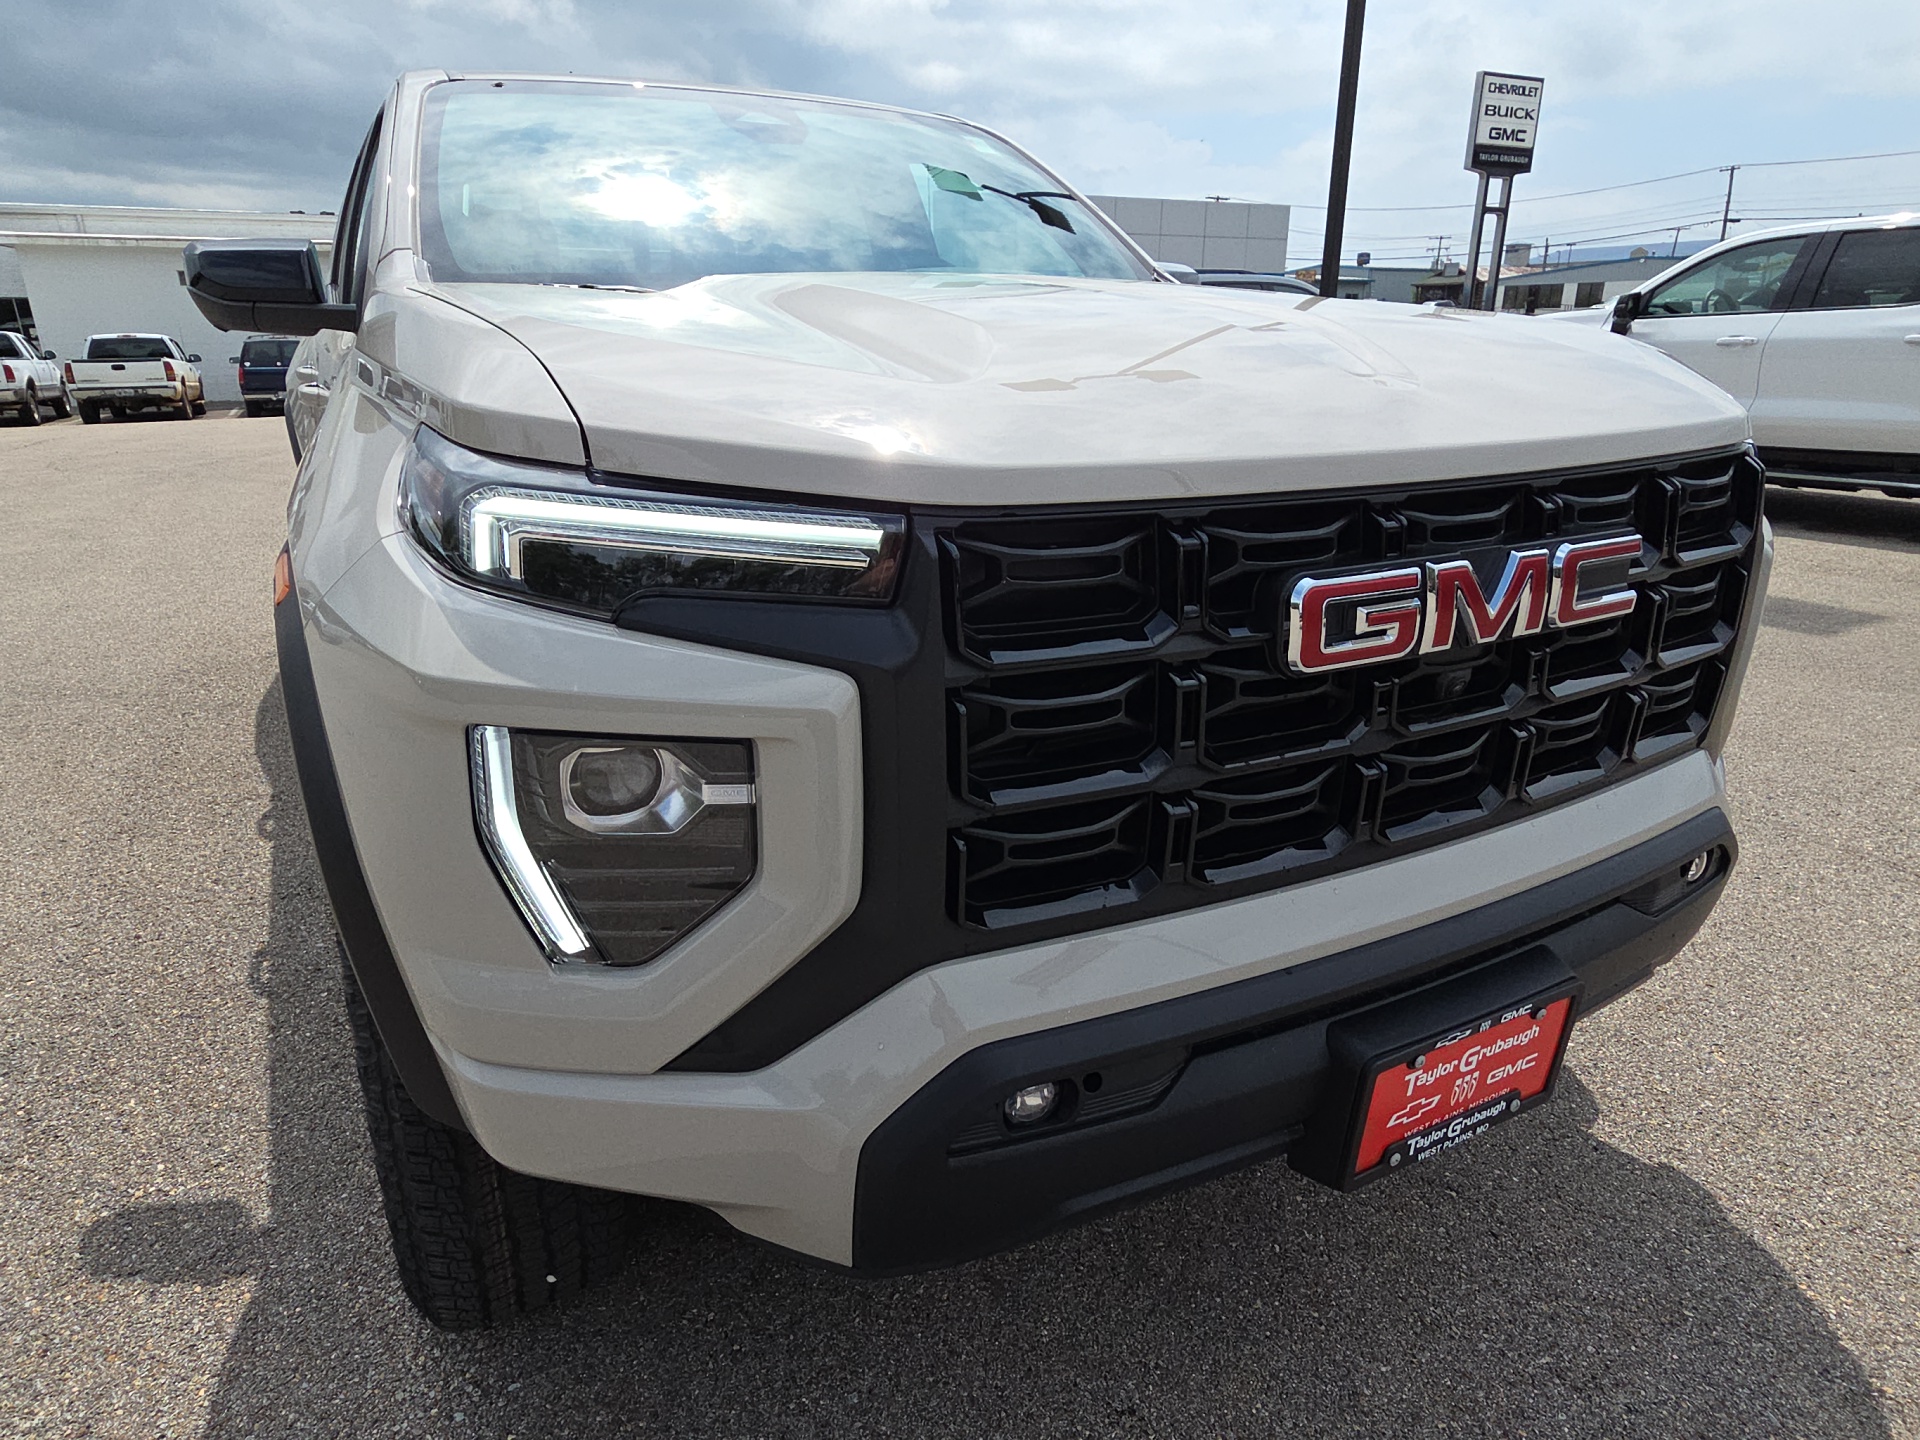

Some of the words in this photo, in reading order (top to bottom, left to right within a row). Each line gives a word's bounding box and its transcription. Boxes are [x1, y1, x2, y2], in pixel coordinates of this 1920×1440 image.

[1488, 82, 1539, 98] CHEVROLET
[1484, 104, 1536, 120] BUICK
[1488, 126, 1528, 143] GMC
[1287, 534, 1643, 674] GMC
[1500, 1003, 1533, 1023] GMC
[1404, 1059, 1459, 1097] Taylor
[1459, 1024, 1540, 1073] Grubaugh
[1486, 1052, 1539, 1085] GMC
[1404, 1121, 1431, 1138] WEST
[1407, 1128, 1447, 1156] Taylor
[1447, 1100, 1507, 1138] Grubaugh
[1418, 1144, 1442, 1161] WEST
[1475, 1122, 1489, 1135] MO
